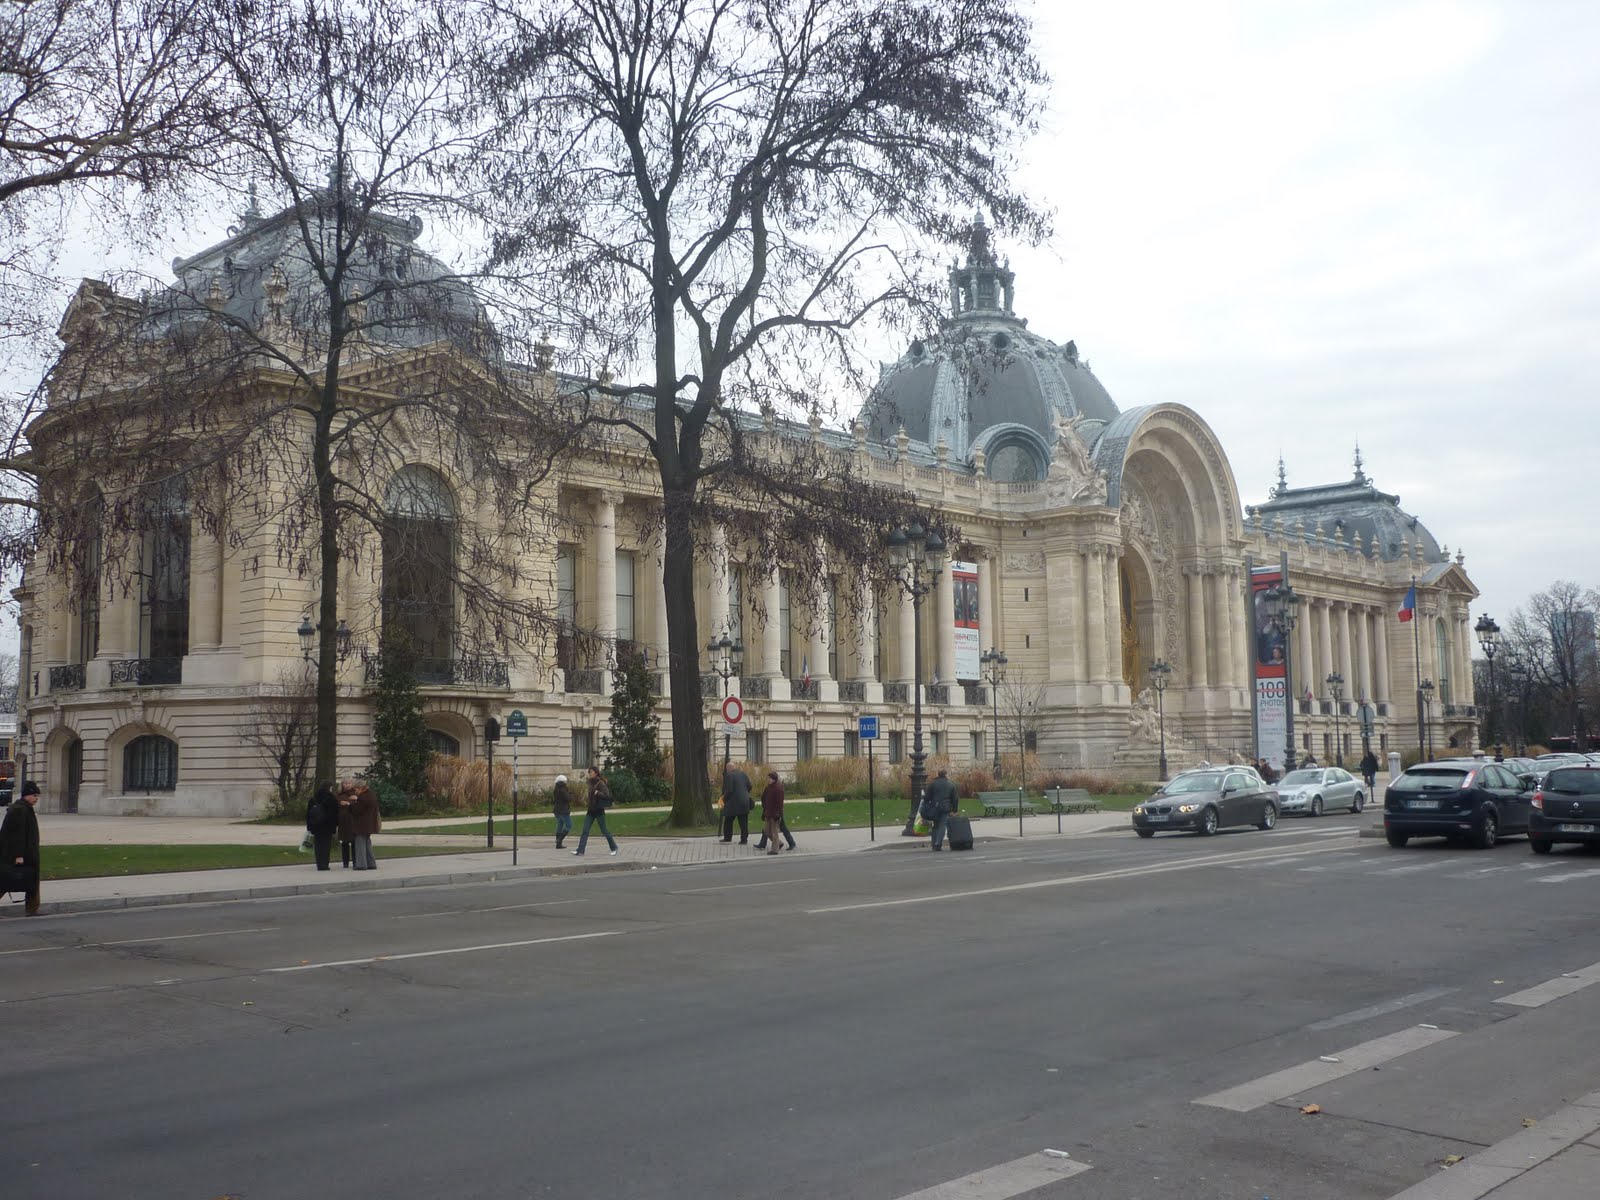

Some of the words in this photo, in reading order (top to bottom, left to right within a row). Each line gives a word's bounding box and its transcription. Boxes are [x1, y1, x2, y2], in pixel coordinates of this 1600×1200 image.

[1259, 681, 1285, 699] 100
[1260, 699, 1285, 707] PHOTOS
[860, 723, 876, 731] TAXIS
